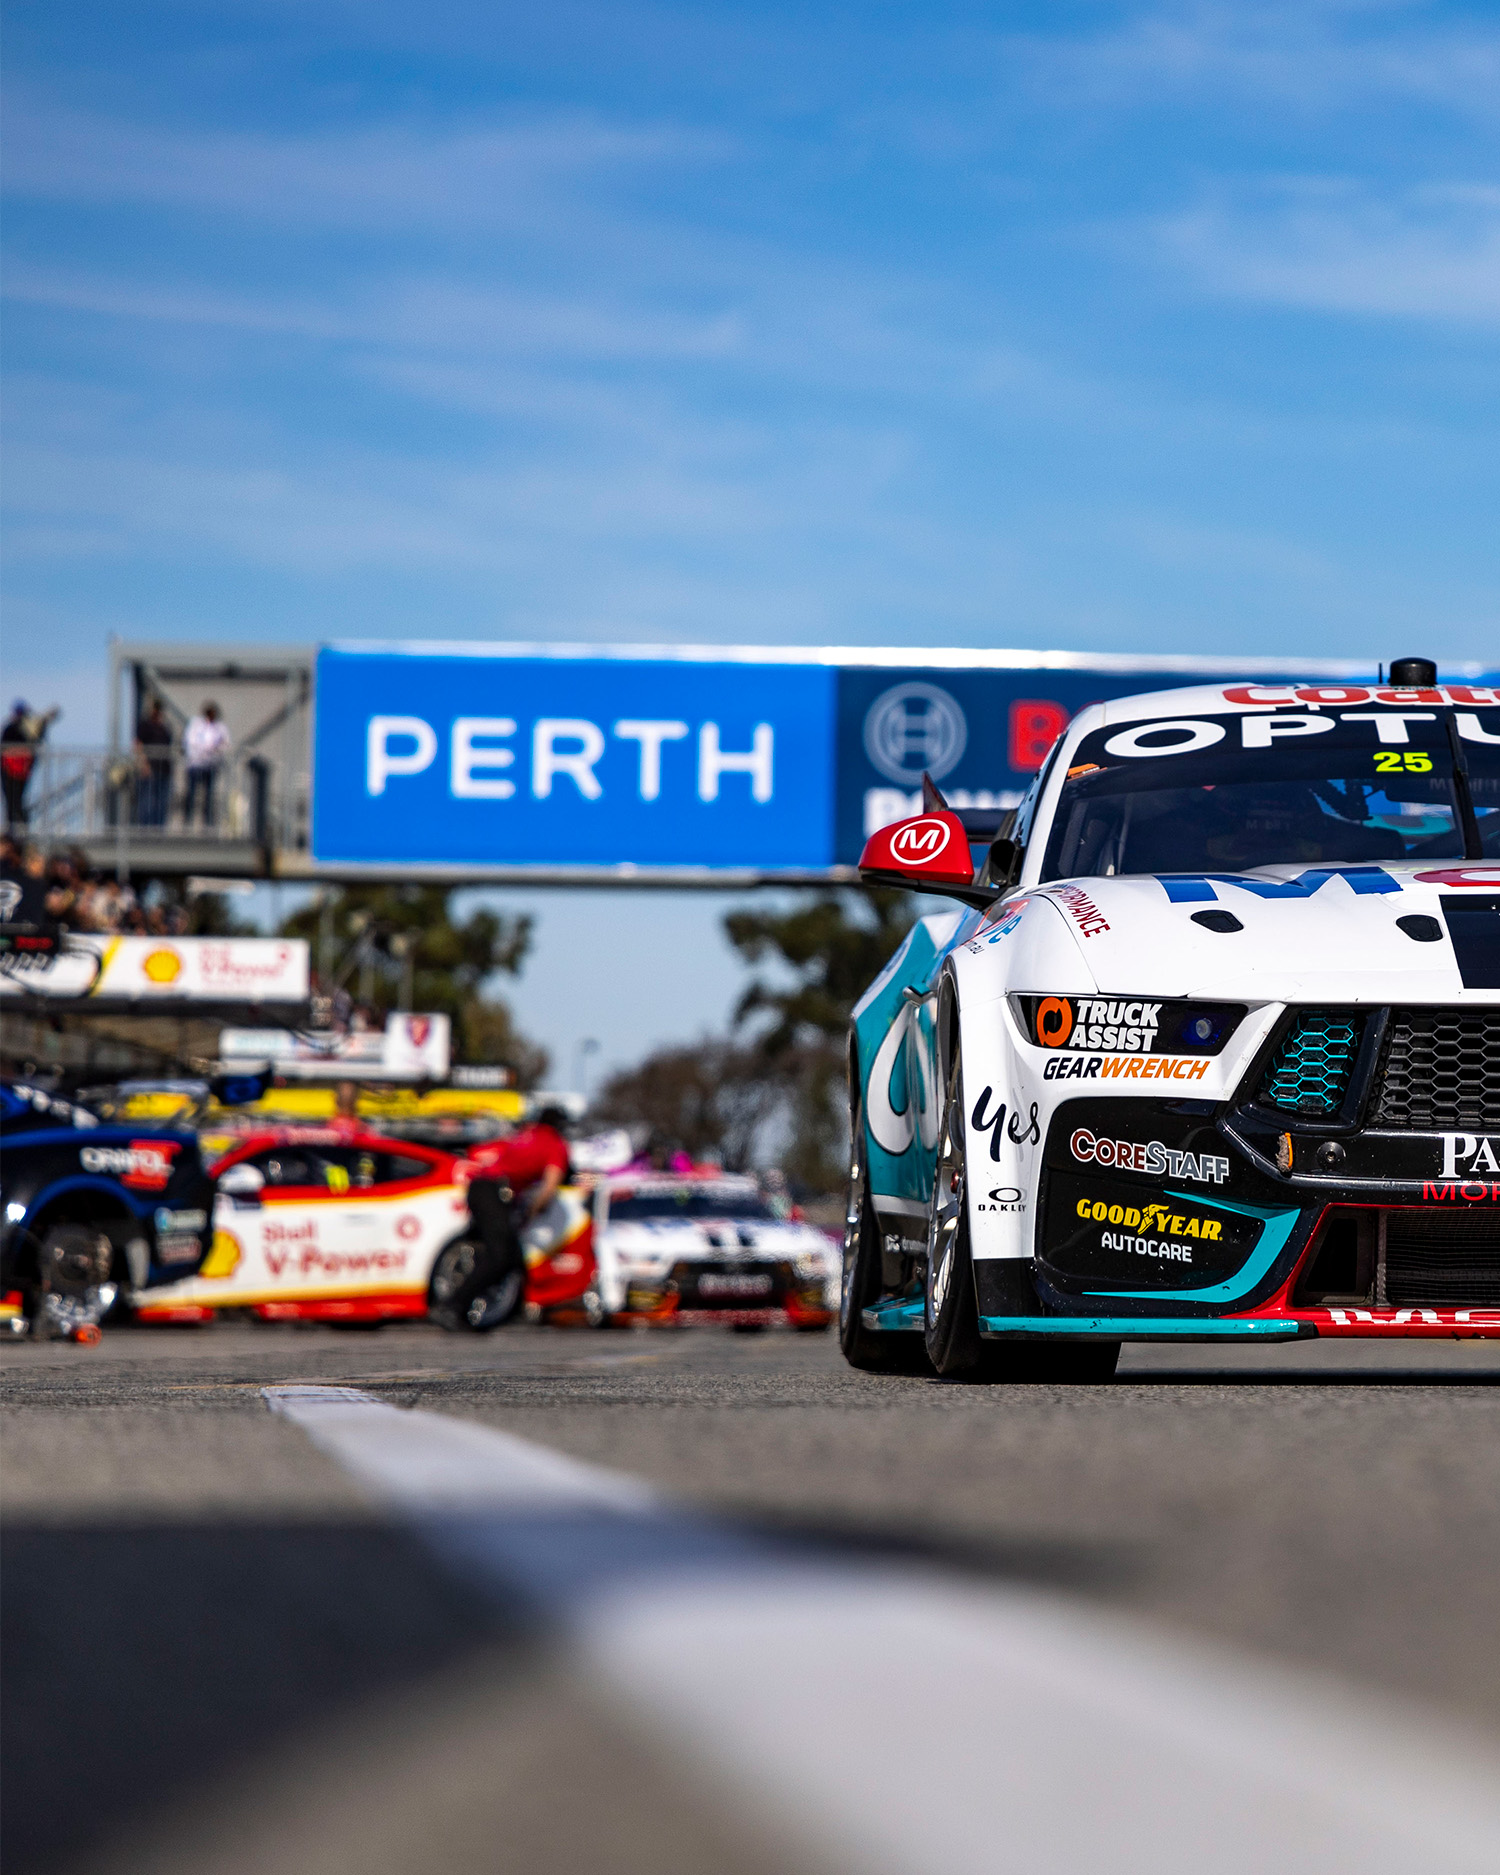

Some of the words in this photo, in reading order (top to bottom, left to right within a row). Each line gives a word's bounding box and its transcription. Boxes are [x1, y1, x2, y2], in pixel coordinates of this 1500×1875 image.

[366, 713, 775, 803] PERTH
[1373, 751, 1433, 773] 25
[1075, 999, 1163, 1027] TRUCK
[1068, 1024, 1159, 1052] ASSIST
[1043, 1056, 1211, 1081] GEARWRENCH
[971, 1085, 1041, 1162] yes
[978, 1202, 1027, 1212] OAKLEY
[1076, 1197, 1224, 1242] GOODYEAR
[264, 1245, 409, 1278] V-Power
[1101, 1231, 1193, 1264] AUTOCARE
